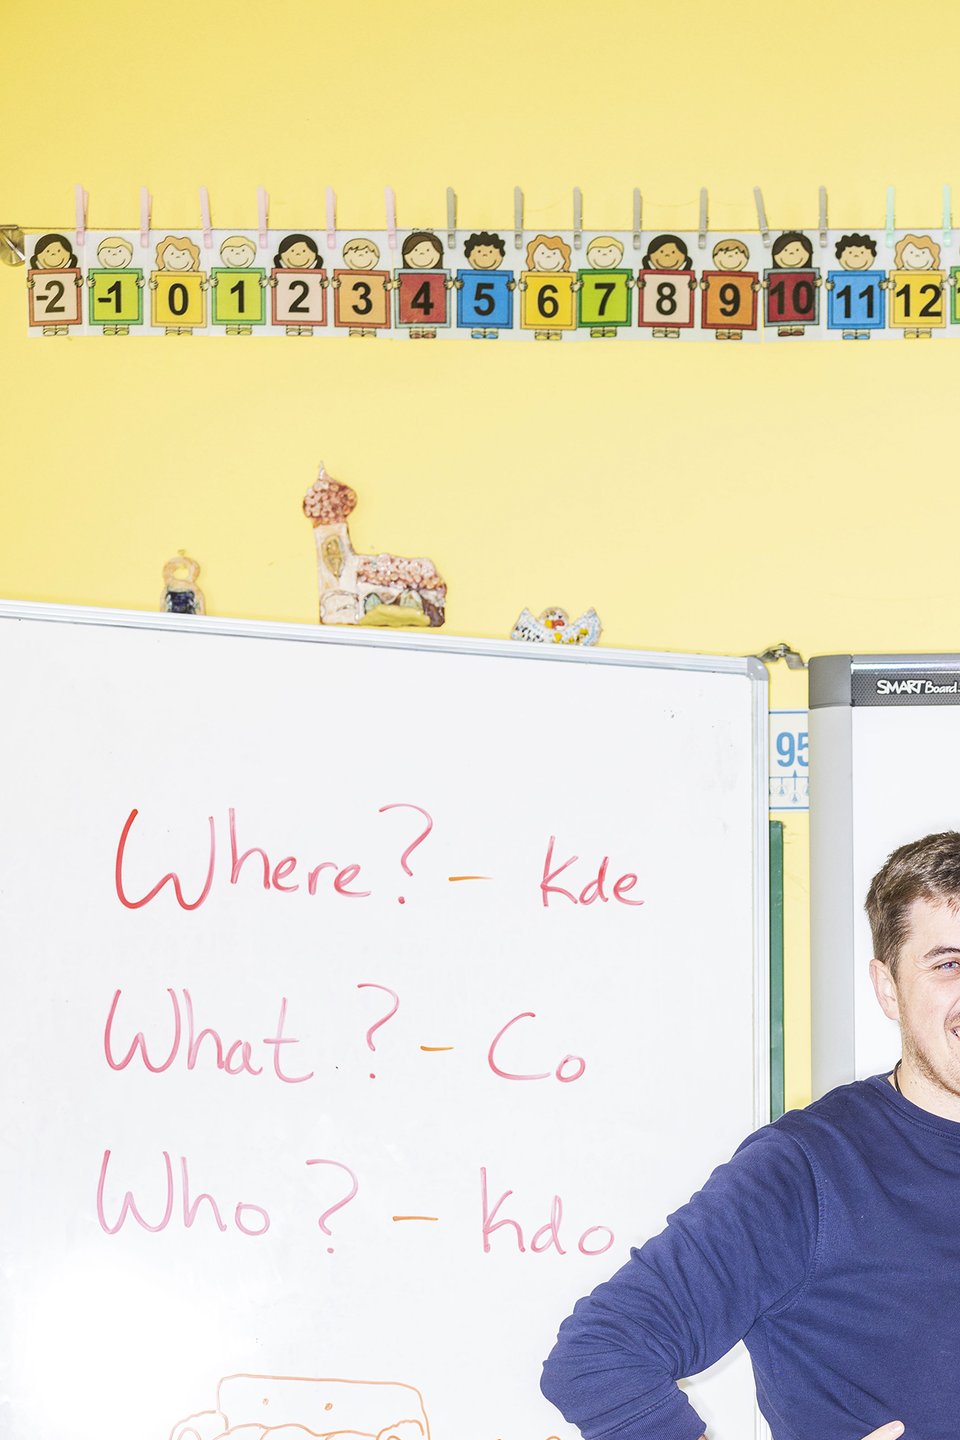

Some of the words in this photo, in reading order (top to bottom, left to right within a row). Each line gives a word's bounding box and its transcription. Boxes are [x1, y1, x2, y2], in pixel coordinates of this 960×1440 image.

[37, 281, 64, 312] -2
[98, 281, 121, 312] -1
[169, 284, 188, 315] 0
[231, 281, 244, 312] 1
[289, 281, 309, 312] 2
[353, 283, 372, 314] 3
[412, 282, 433, 315] 4
[475, 283, 494, 315] 5
[538, 285, 558, 317] 6
[595, 283, 615, 315] 7
[657, 283, 676, 315] 8
[720, 284, 740, 316] 9
[769, 281, 813, 314] 10
[837, 285, 873, 318] 11
[897, 285, 941, 316] 12
[776, 731, 809, 768] 95
